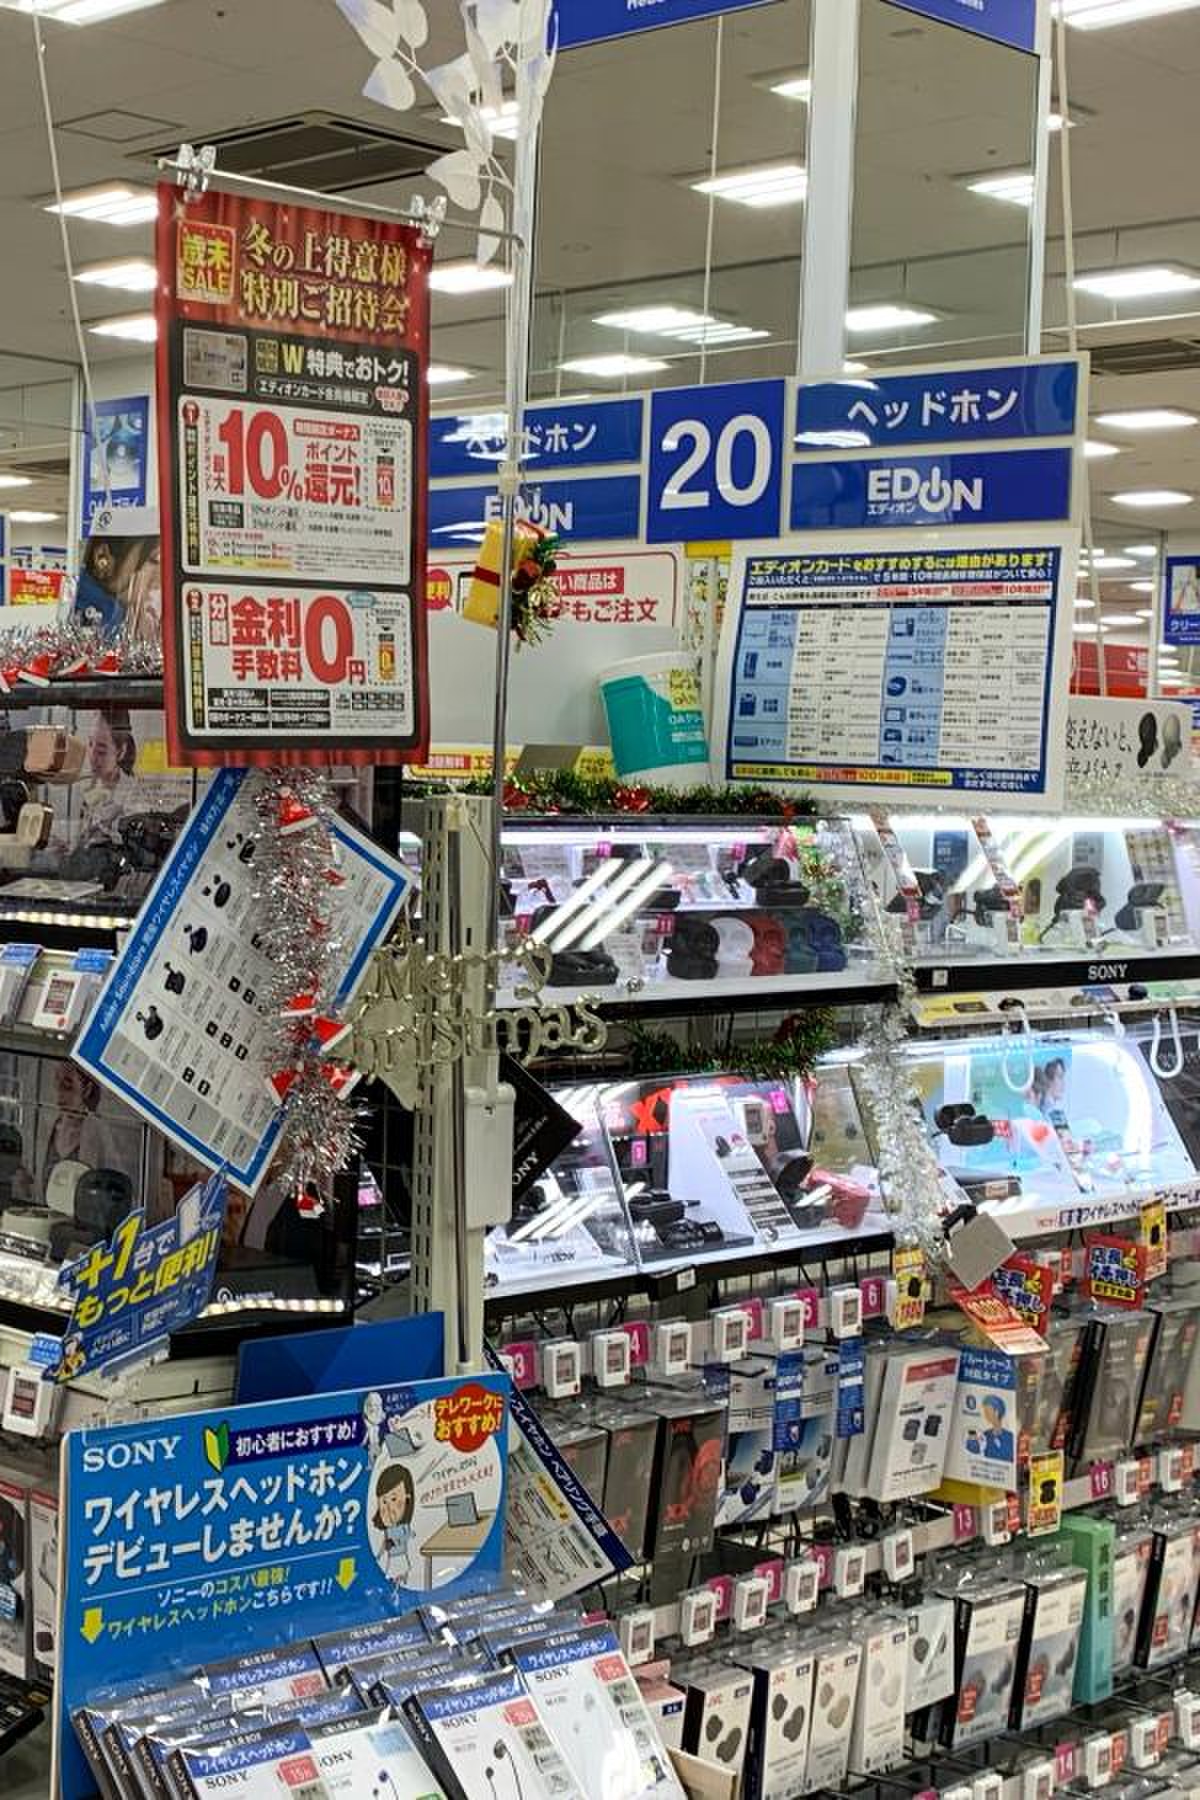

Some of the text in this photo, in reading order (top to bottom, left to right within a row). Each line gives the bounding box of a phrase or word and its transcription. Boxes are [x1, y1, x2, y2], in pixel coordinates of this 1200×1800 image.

[242, 222, 407, 288] 冬の上得意様
[183, 266, 230, 292] SALE
[240, 270, 411, 334] 特別ご招待会
[847, 387, 1019, 430] ヘッドホン
[305, 441, 359, 464] ポイント
[659, 414, 772, 512] 20
[867, 501, 916, 516] エディオン
[231, 595, 302, 648] 金利
[231, 650, 304, 682] 手数料
[1087, 964, 1128, 981] SONY
[630, 1329, 641, 1356] 4
[514, 1353, 525, 1379] 3
[434, 1393, 504, 1419] テレワークに
[235, 1419, 358, 1459] 初心者におすすめ!
[435, 1411, 503, 1442] おすすめ!
[82, 1435, 182, 1474] SONY
[83, 1460, 364, 1538] ワイヤレスヘッドホン
[83, 1498, 361, 1586] デビューしませんか?
[205, 1770, 249, 1789] SONY
